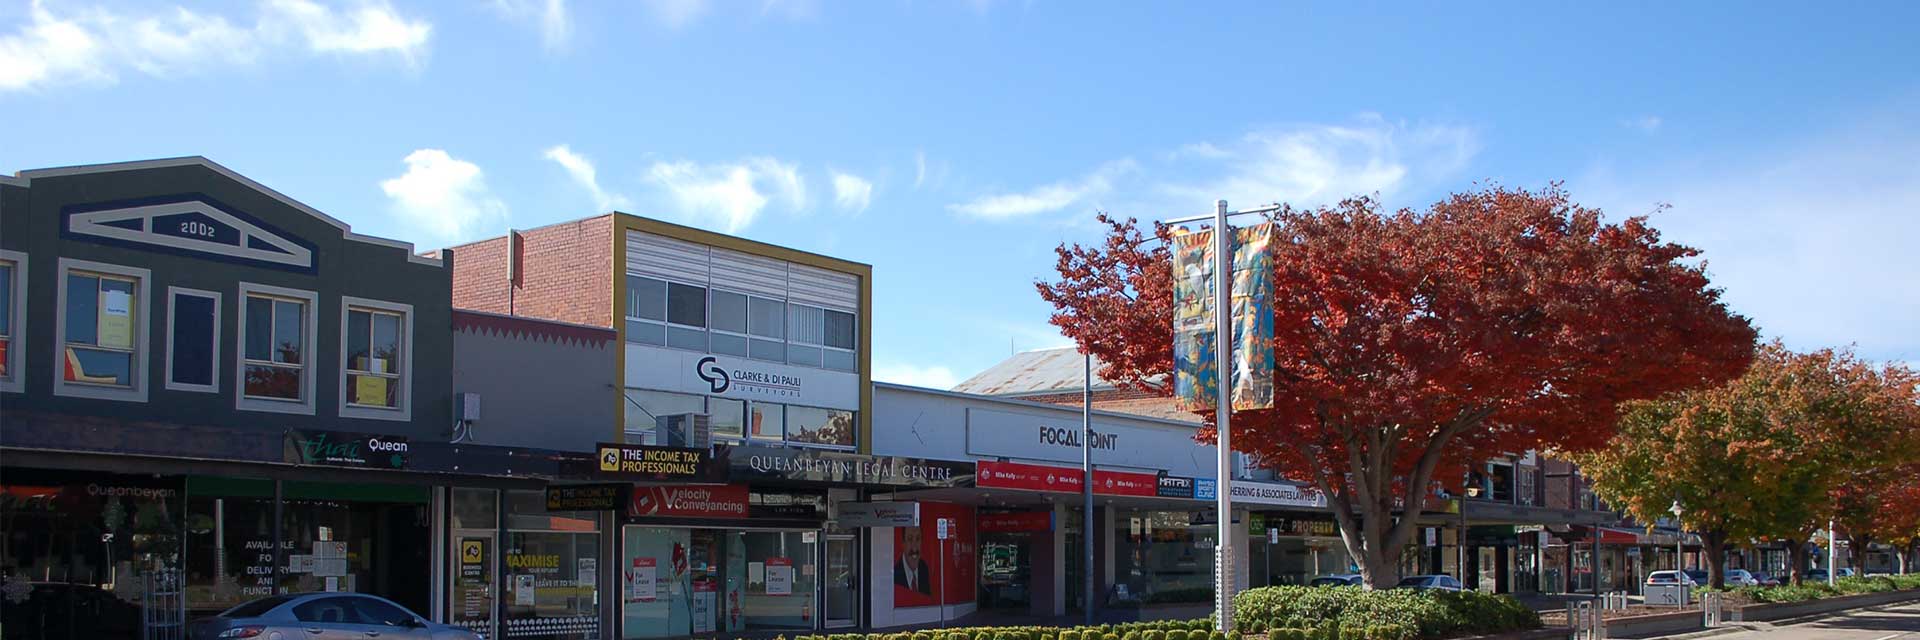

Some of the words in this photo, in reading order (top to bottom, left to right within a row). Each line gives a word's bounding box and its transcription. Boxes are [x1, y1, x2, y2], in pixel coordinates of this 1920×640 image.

[181, 221, 215, 237] 2002
[733, 370, 762, 381] CLARKE
[764, 374, 770, 383] &
[772, 374, 780, 382] DI
[781, 376, 801, 387] PAULI
[1039, 426, 1082, 447] FOCAL
[368, 438, 408, 452] Quean
[622, 449, 642, 460] THE
[644, 450, 680, 462] INCOME
[682, 452, 700, 463] TAX
[621, 461, 696, 475] PROFESSIONALS
[750, 455, 849, 474] QUEANBEYAN
[856, 463, 897, 477] LEGAL
[902, 465, 951, 480] CENTRE
[87, 483, 176, 499] Queanbeyan
[660, 486, 711, 509] Velocity
[1231, 486, 1255, 497] HERRING
[1255, 489, 1260, 498] &
[1261, 489, 1293, 500] ASSOCIATES
[674, 498, 743, 513] Conveyancing
[1291, 520, 1334, 534] PROPERTY
[245, 541, 295, 550] AVAILLE
[259, 554, 272, 563] FO
[247, 566, 290, 575] DELIVRY
[257, 577, 273, 585] AN
[243, 587, 289, 596] FUNCTN
